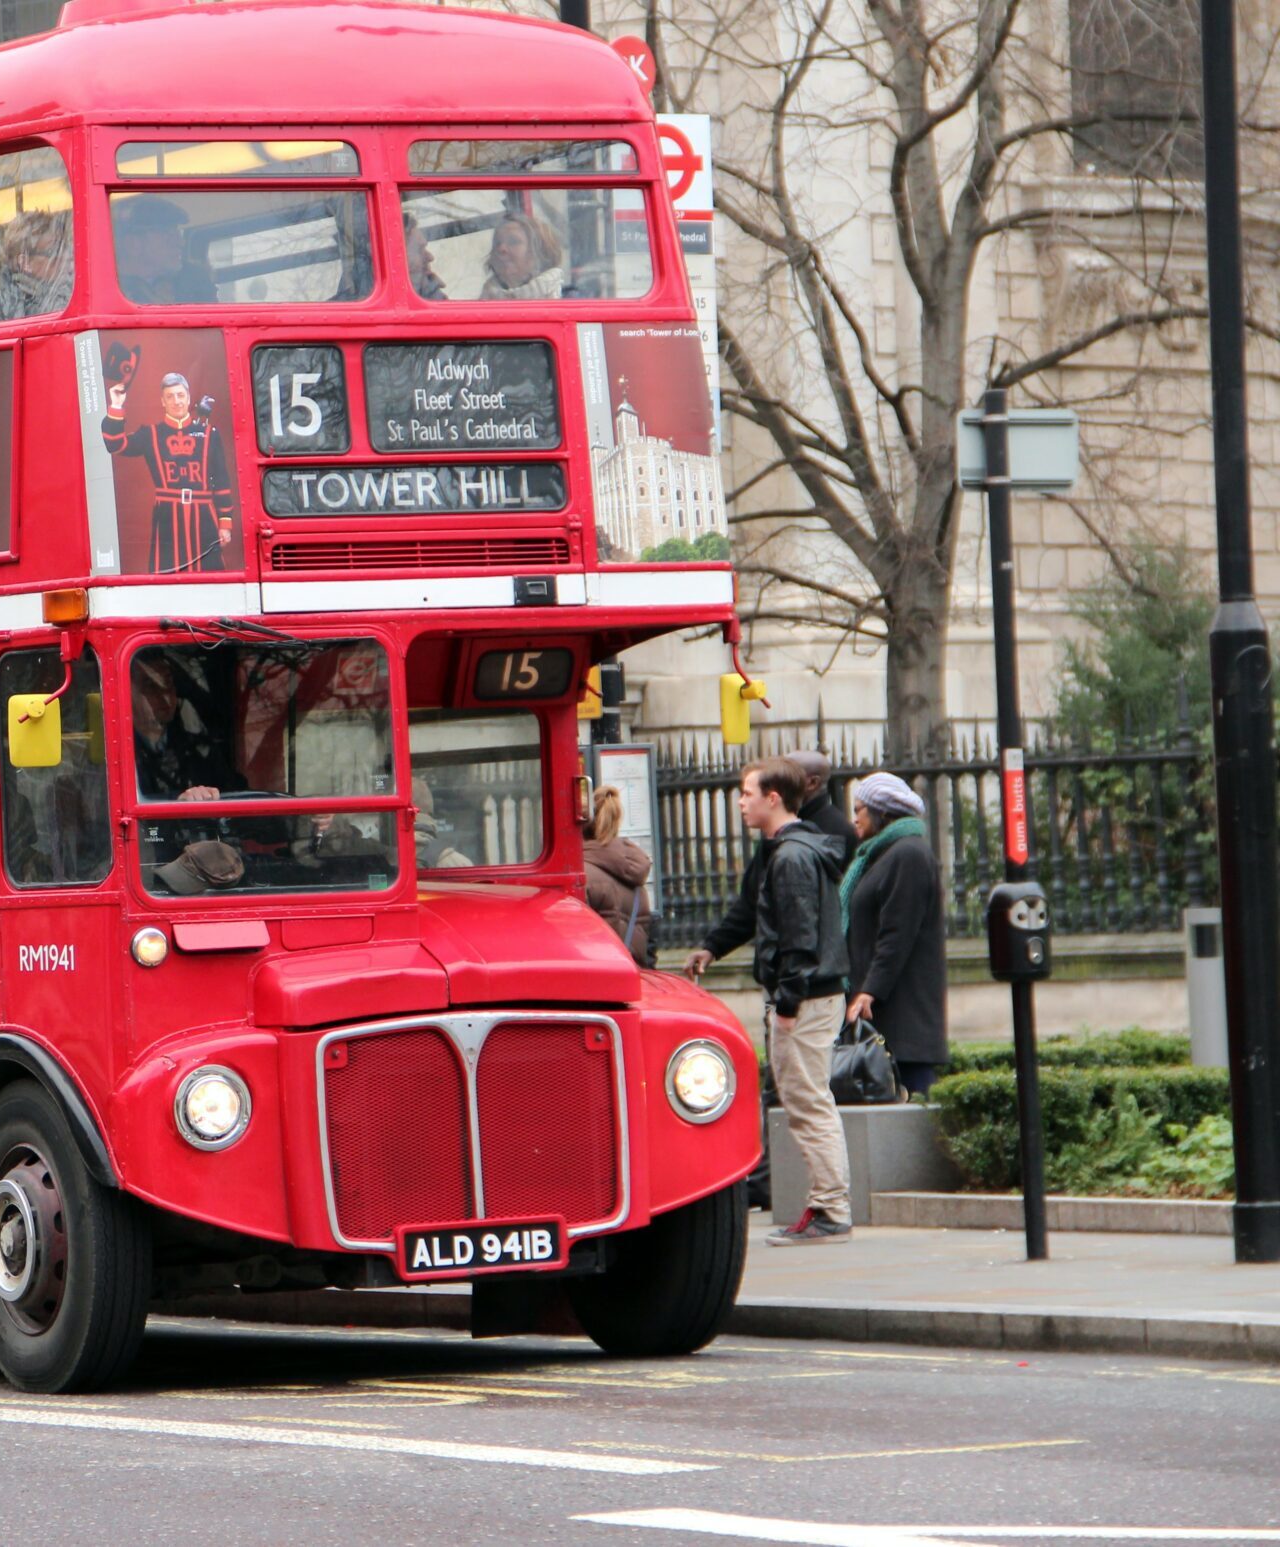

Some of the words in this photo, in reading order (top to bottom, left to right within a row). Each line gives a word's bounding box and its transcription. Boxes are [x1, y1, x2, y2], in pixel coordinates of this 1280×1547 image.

[680, 232, 707, 242] hedral
[620, 328, 646, 337] search
[674, 327, 682, 337] of
[82, 370, 89, 378] of
[427, 358, 490, 386] Aldwych
[83, 381, 92, 414] London
[269, 373, 322, 437] 15
[414, 389, 453, 411] Fleet
[460, 388, 507, 411] Street
[387, 420, 404, 442] St
[411, 419, 459, 441] Paul's
[466, 417, 539, 440] Cathedral
[292, 472, 441, 508] TOWER
[459, 469, 543, 506] HILL
[501, 651, 543, 691] 15
[1012, 776, 1024, 812] butts
[1016, 822, 1027, 852] gum
[19, 944, 74, 971] RM1941
[412, 1235, 475, 1268] ALD
[481, 1229, 553, 1263] 941B
